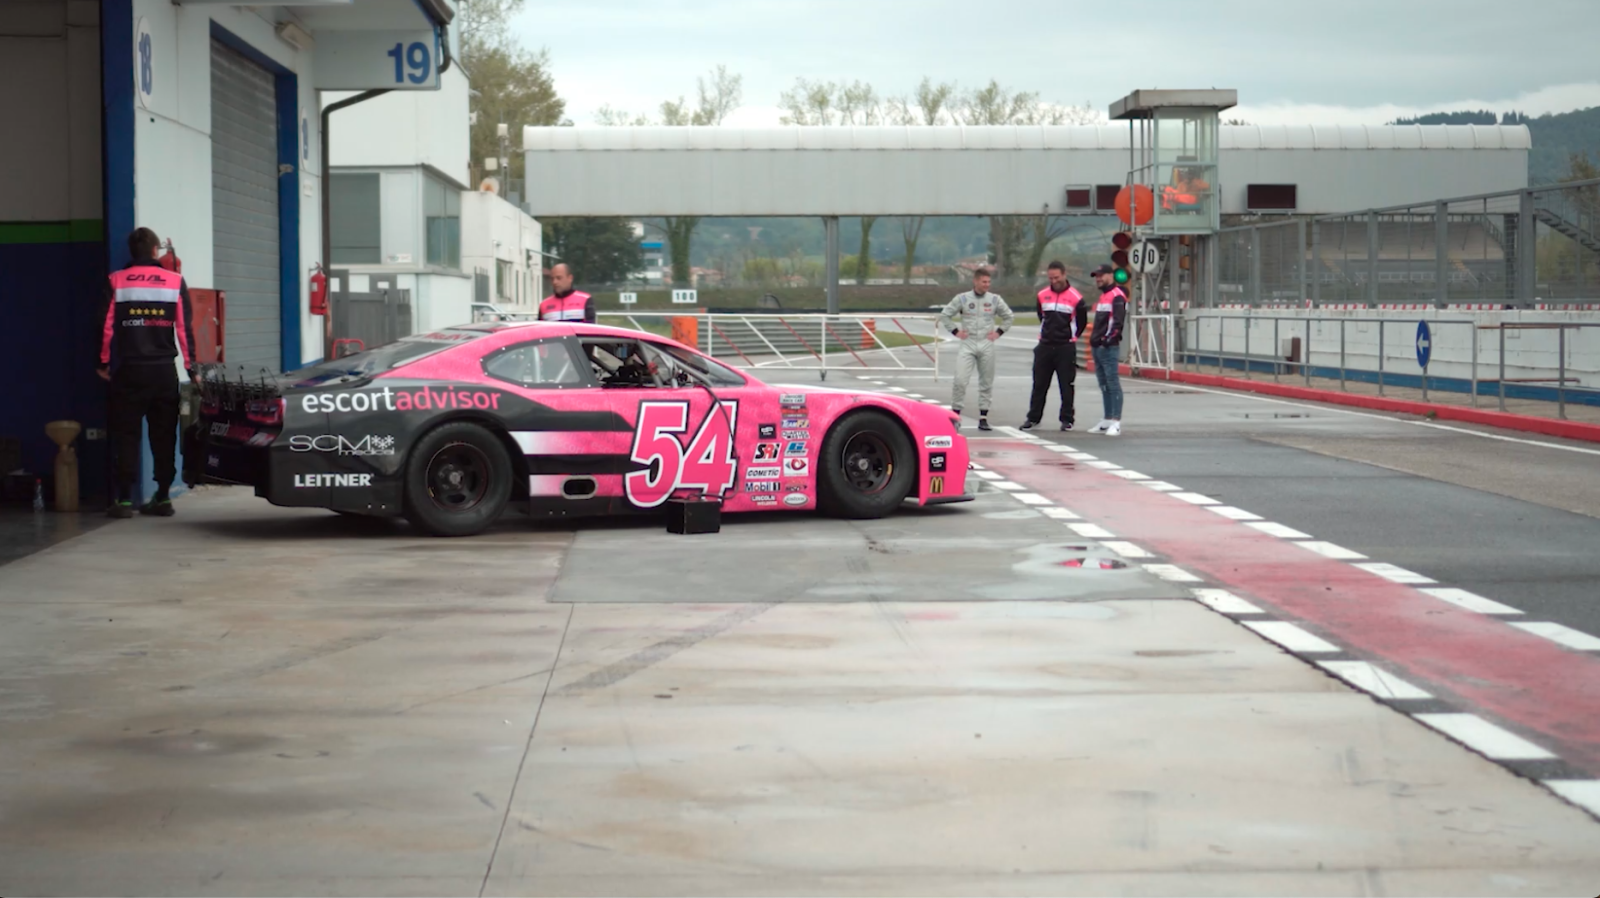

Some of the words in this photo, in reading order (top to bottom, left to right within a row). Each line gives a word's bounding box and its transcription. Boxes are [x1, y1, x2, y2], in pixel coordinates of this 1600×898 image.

[138, 32, 153, 96] 18
[387, 41, 431, 84] 19
[675, 292, 695, 301] 100
[302, 385, 501, 413] escortadvisor
[289, 434, 371, 452] SCM
[338, 447, 395, 456] medical
[624, 400, 738, 508] 54
[294, 473, 372, 487] LEITNER
[745, 482, 770, 491] Mobil
